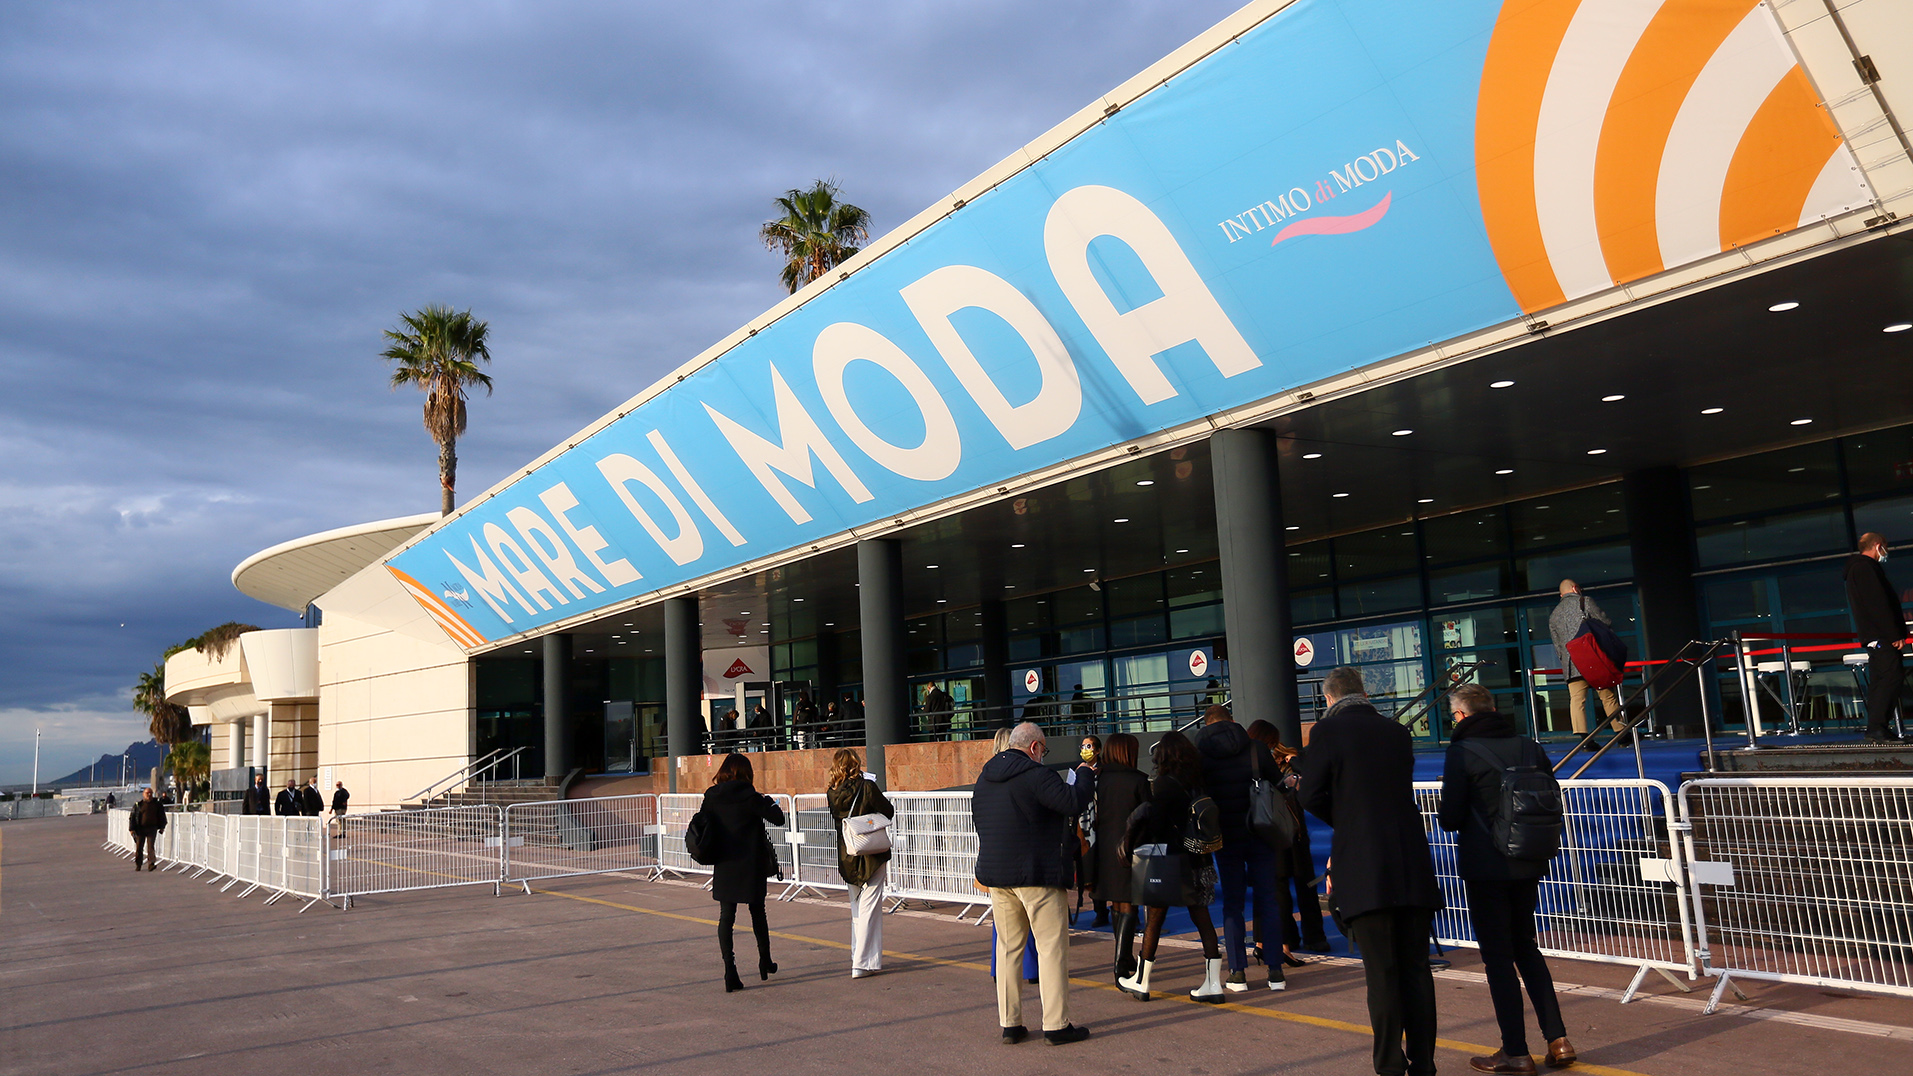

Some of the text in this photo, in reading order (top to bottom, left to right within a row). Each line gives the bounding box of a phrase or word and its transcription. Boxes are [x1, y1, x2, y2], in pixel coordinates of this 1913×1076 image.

[1217, 139, 1421, 244] INTIMO di MODA
[441, 185, 1264, 625] MARE DI MODA
[730, 665, 748, 673] LYCRA
